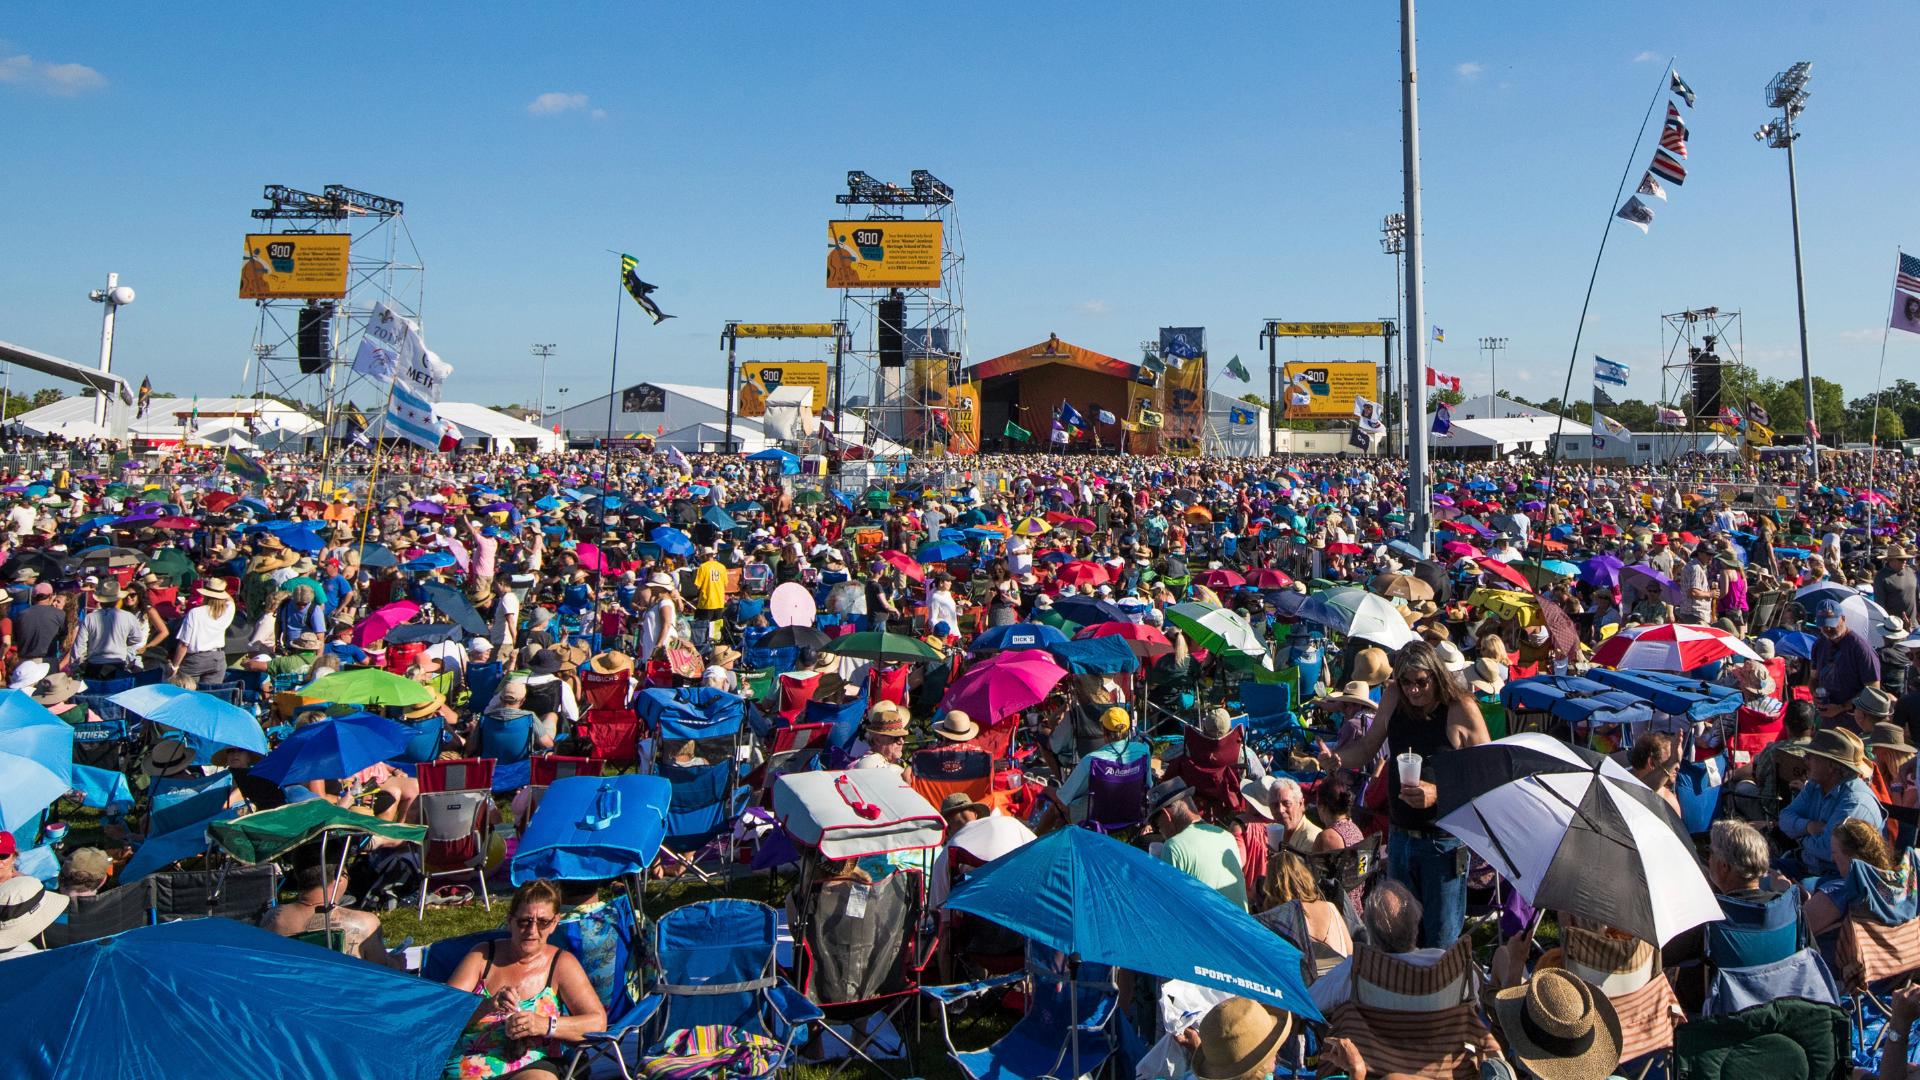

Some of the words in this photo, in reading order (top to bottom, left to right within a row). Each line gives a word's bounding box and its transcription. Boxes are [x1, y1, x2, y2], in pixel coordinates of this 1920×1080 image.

[857, 231, 878, 245] 300
[270, 244, 290, 258] 300
[763, 370, 779, 382] 300
[711, 569, 720, 582] 19
[74, 730, 110, 739] NTHERS
